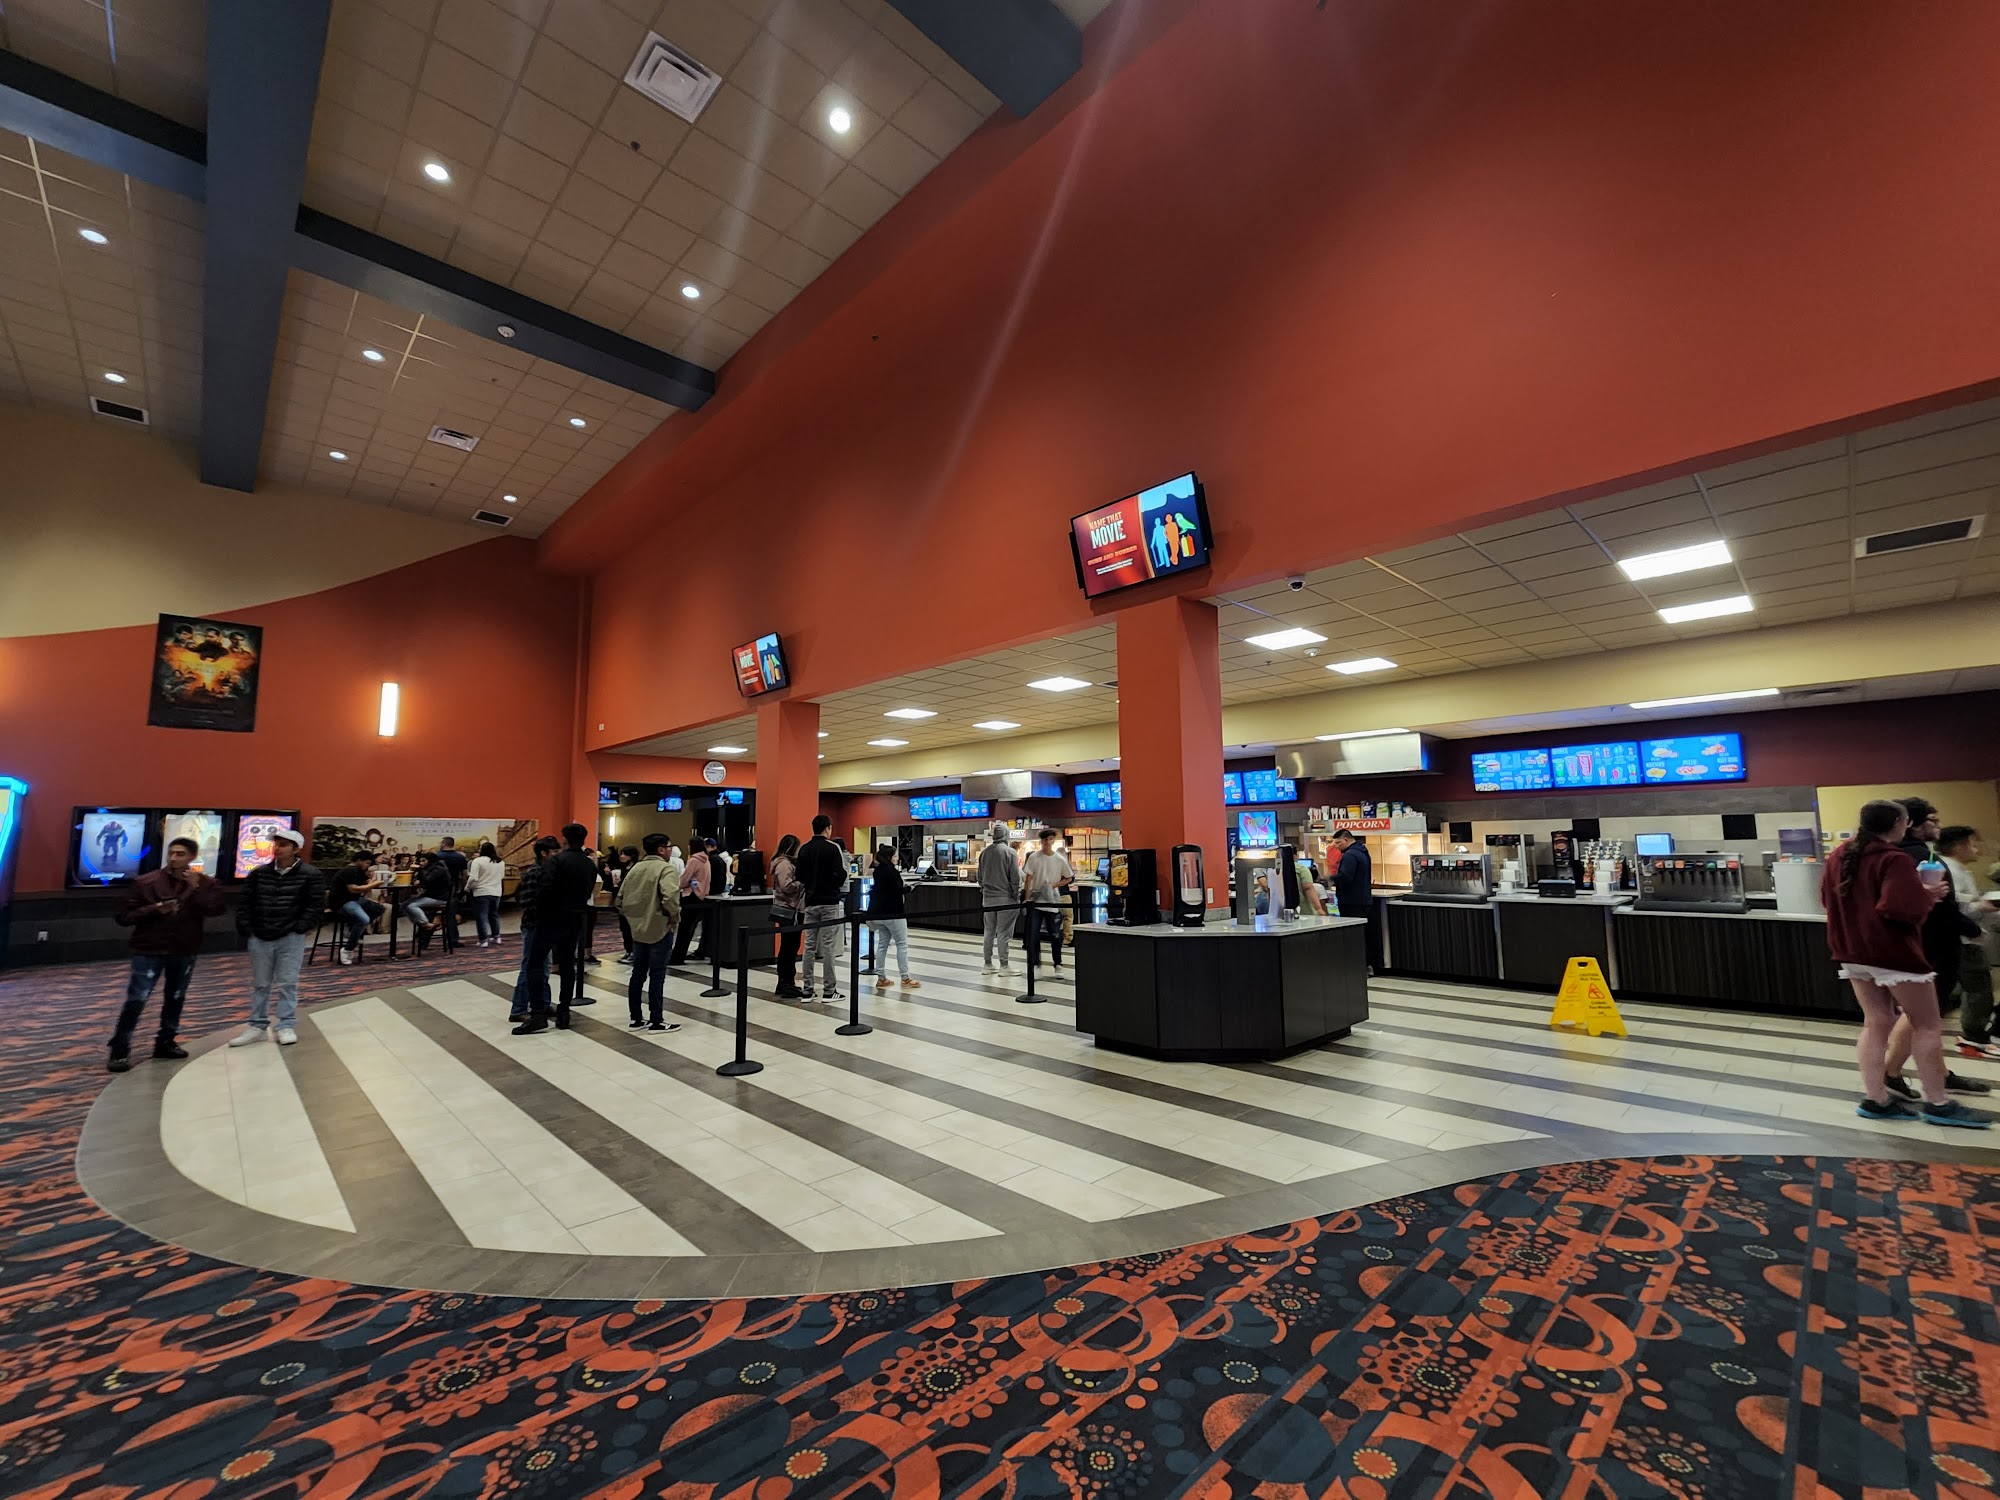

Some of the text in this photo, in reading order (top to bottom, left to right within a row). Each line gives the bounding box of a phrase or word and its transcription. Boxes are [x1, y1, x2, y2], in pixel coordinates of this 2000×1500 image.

[1089, 511, 1122, 531] NAME THAT
[1090, 519, 1127, 550] MOVIE
[1335, 820, 1387, 829] POPCORN
